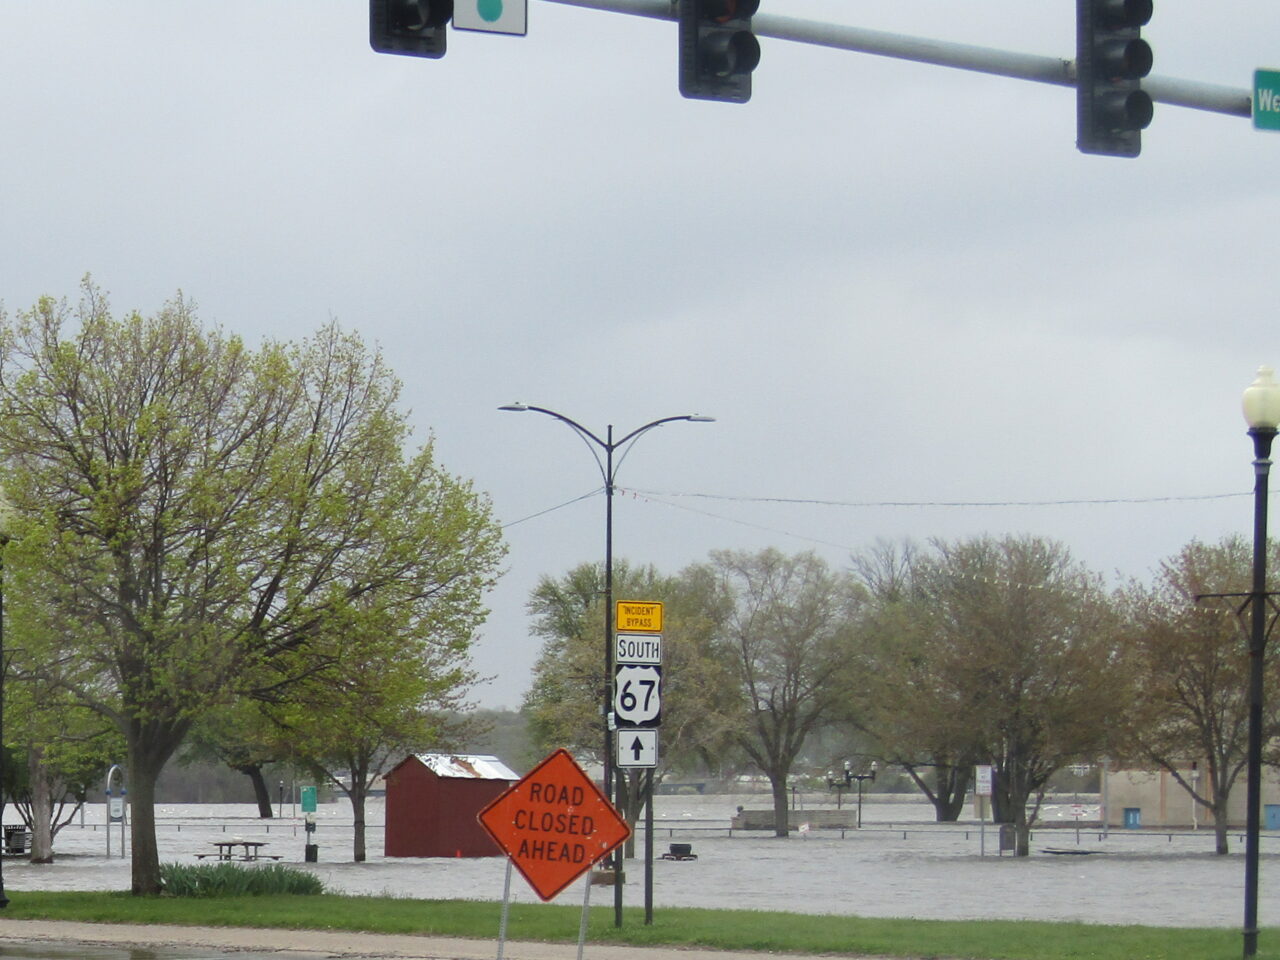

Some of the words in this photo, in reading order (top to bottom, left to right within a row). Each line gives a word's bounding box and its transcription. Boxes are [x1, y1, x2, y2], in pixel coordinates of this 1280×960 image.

[624, 606, 654, 616] INCIDENT
[626, 618, 652, 627] BYPASS
[618, 639, 659, 659] SOUTH
[620, 680, 655, 711] 67
[529, 783, 585, 806] ROAD
[514, 809, 594, 836] CLOSED
[517, 839, 585, 863] AHEAD
